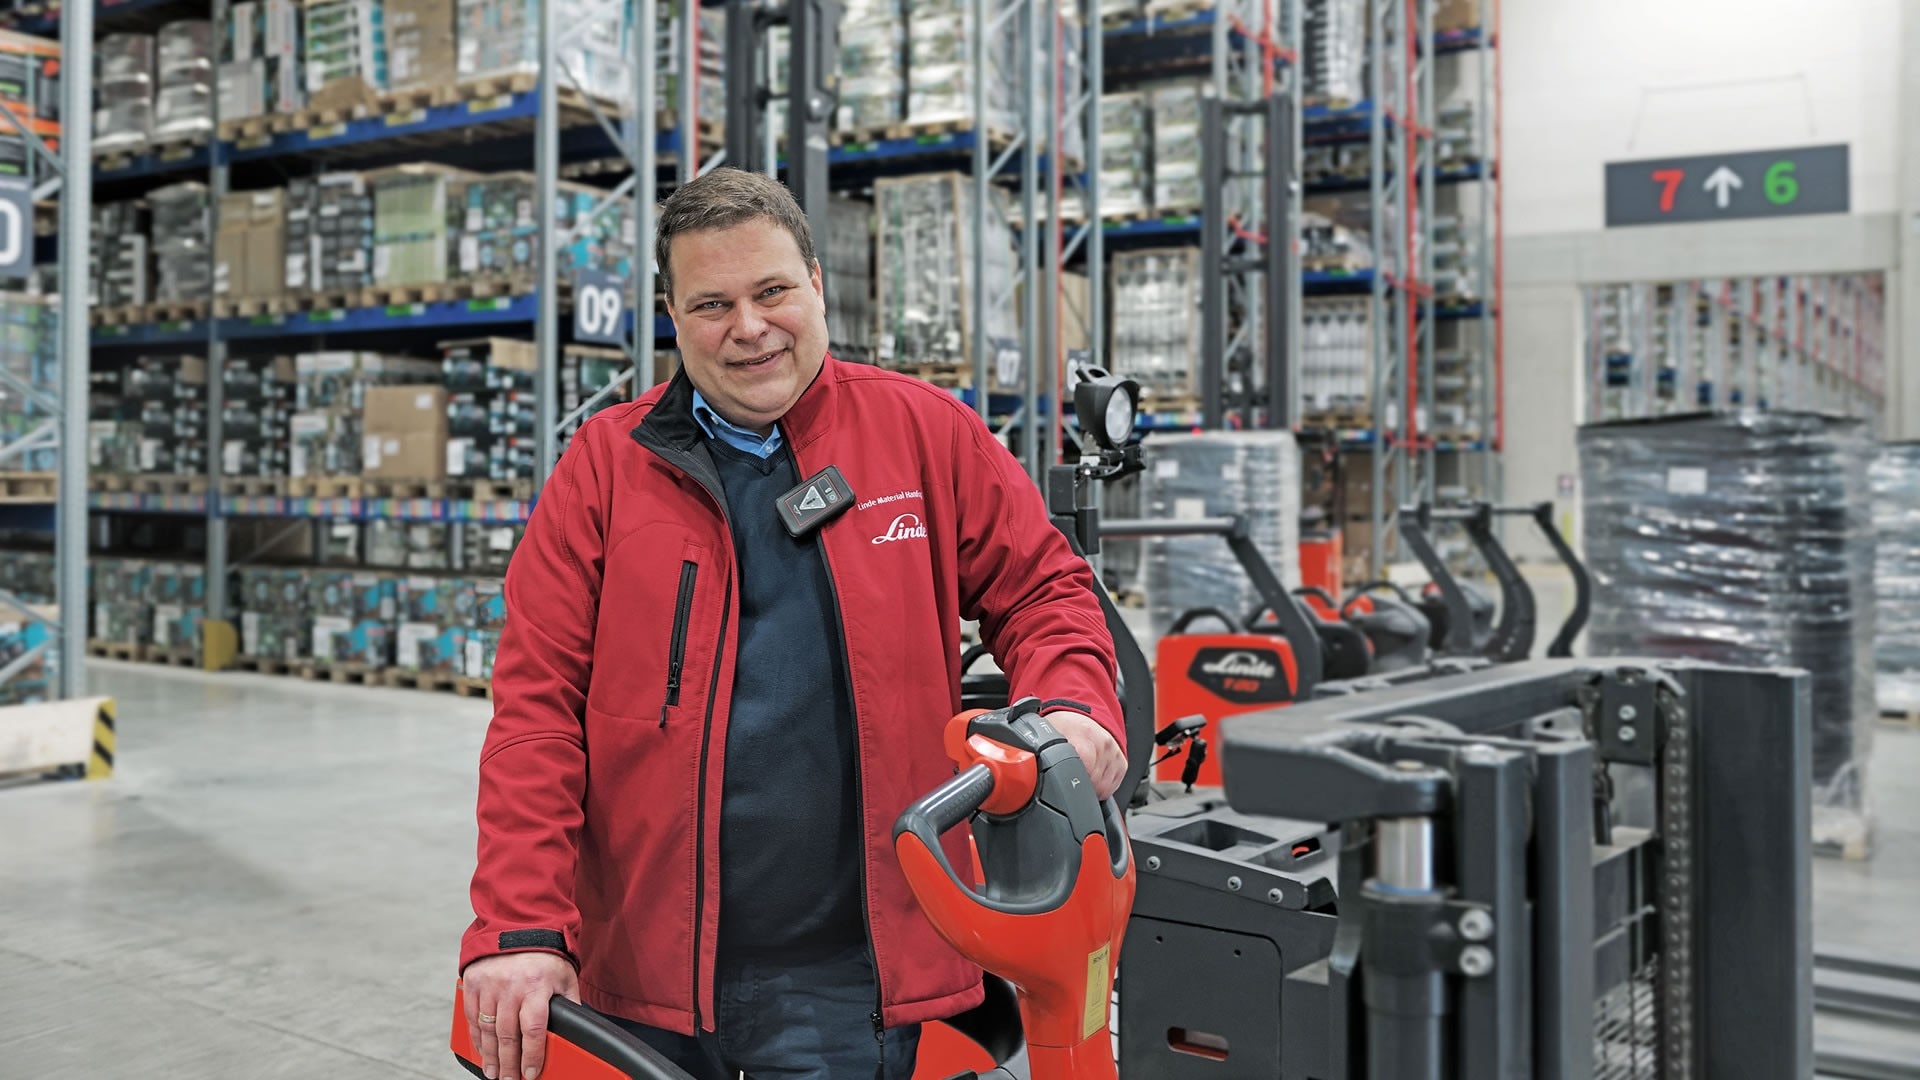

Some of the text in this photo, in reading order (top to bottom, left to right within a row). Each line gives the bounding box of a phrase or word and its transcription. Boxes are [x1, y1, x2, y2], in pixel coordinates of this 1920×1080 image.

[1651, 160, 1798, 213] 7 6
[579, 285, 621, 336] 09
[857, 500, 877, 511] Linde
[877, 491, 905, 504] Material
[1202, 651, 1275, 678] Linde
